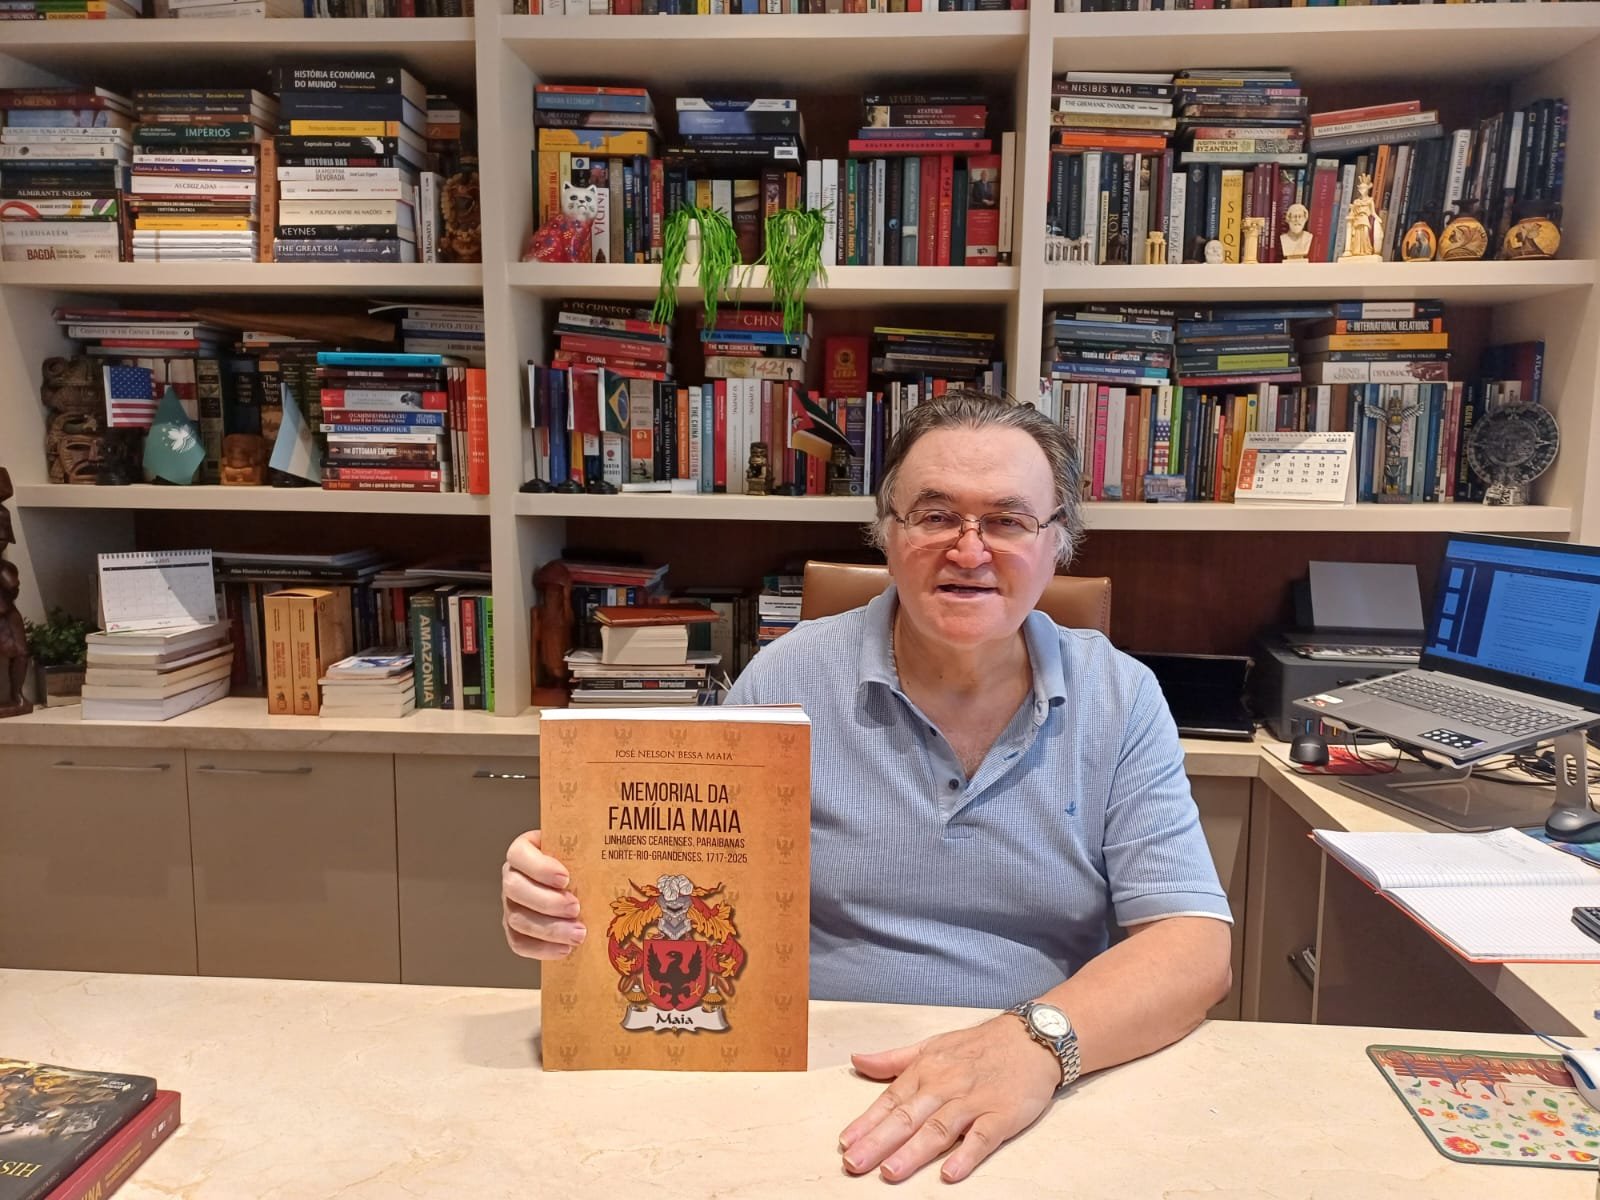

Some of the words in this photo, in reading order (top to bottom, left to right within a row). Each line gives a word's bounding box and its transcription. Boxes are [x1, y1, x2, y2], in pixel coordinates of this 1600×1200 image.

[294, 69, 328, 79] HISTÓRIA
[330, 70, 375, 80] ECONÔMICA
[294, 80, 306, 88] DO
[308, 80, 337, 89] MUNDO
[1071, 84, 1108, 93] NISIBIS
[1110, 86, 1132, 94] WAR
[847, 193, 857, 233] PLANETA
[281, 227, 317, 236] KEYNES
[27, 246, 57, 260] BAGDÁ
[743, 314, 782, 326] CHIN
[1353, 321, 1397, 332] INTERNATIONAL
[1398, 321, 1429, 331] RELATIONS
[586, 356, 607, 365] CHINA
[1533, 354, 1543, 380] ATLAS
[752, 360, 785, 376] 1421
[691, 406, 700, 418] THE
[344, 425, 374, 433] REINADO
[691, 419, 700, 439] CHINA
[352, 447, 377, 455] OTTOMAN
[377, 448, 397, 456] EMPIRE
[418, 614, 434, 703] AMAZÔNIA
[615, 747, 636, 759] JOSÉ
[637, 751, 675, 759] NELSON
[678, 751, 704, 760] BESSA
[706, 752, 733, 761] MAIA
[621, 782, 703, 803] MEMORIAL
[708, 784, 729, 804] DA
[608, 803, 686, 831] FAMÍLIA
[691, 809, 742, 834] MAIA
[604, 836, 647, 846] LINHAGENS
[648, 836, 695, 848] CEARENSES,
[696, 837, 745, 849] PARAIBANAS
[601, 851, 607, 860] E
[608, 850, 704, 863] NORTE-RIO-GRANDENSES,
[706, 853, 748, 864] 1717-2025
[655, 1012, 694, 1025] Maia
[0, 1160, 43, 1178] HIS
